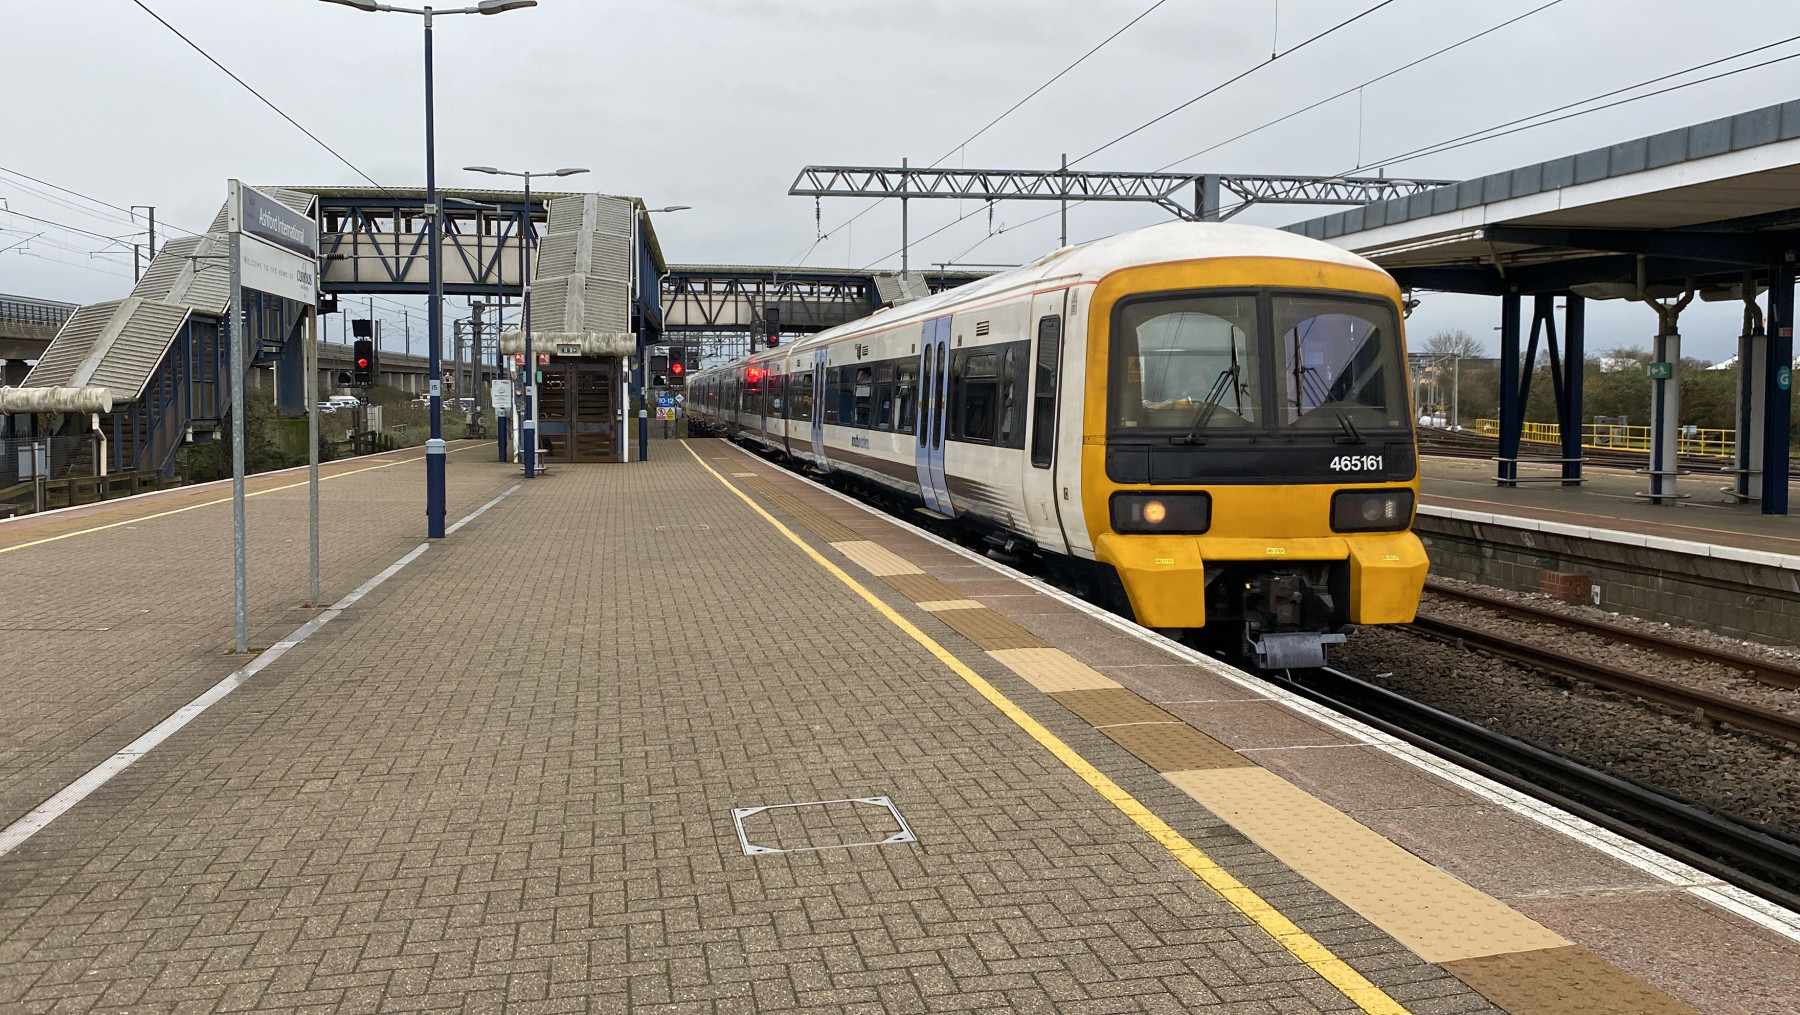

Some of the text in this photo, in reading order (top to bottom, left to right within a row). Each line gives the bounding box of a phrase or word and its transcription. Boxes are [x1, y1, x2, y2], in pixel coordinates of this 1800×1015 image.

[259, 208, 305, 243] Ashford International
[1779, 374, 1789, 385] G
[1330, 455, 1383, 471] 465161
